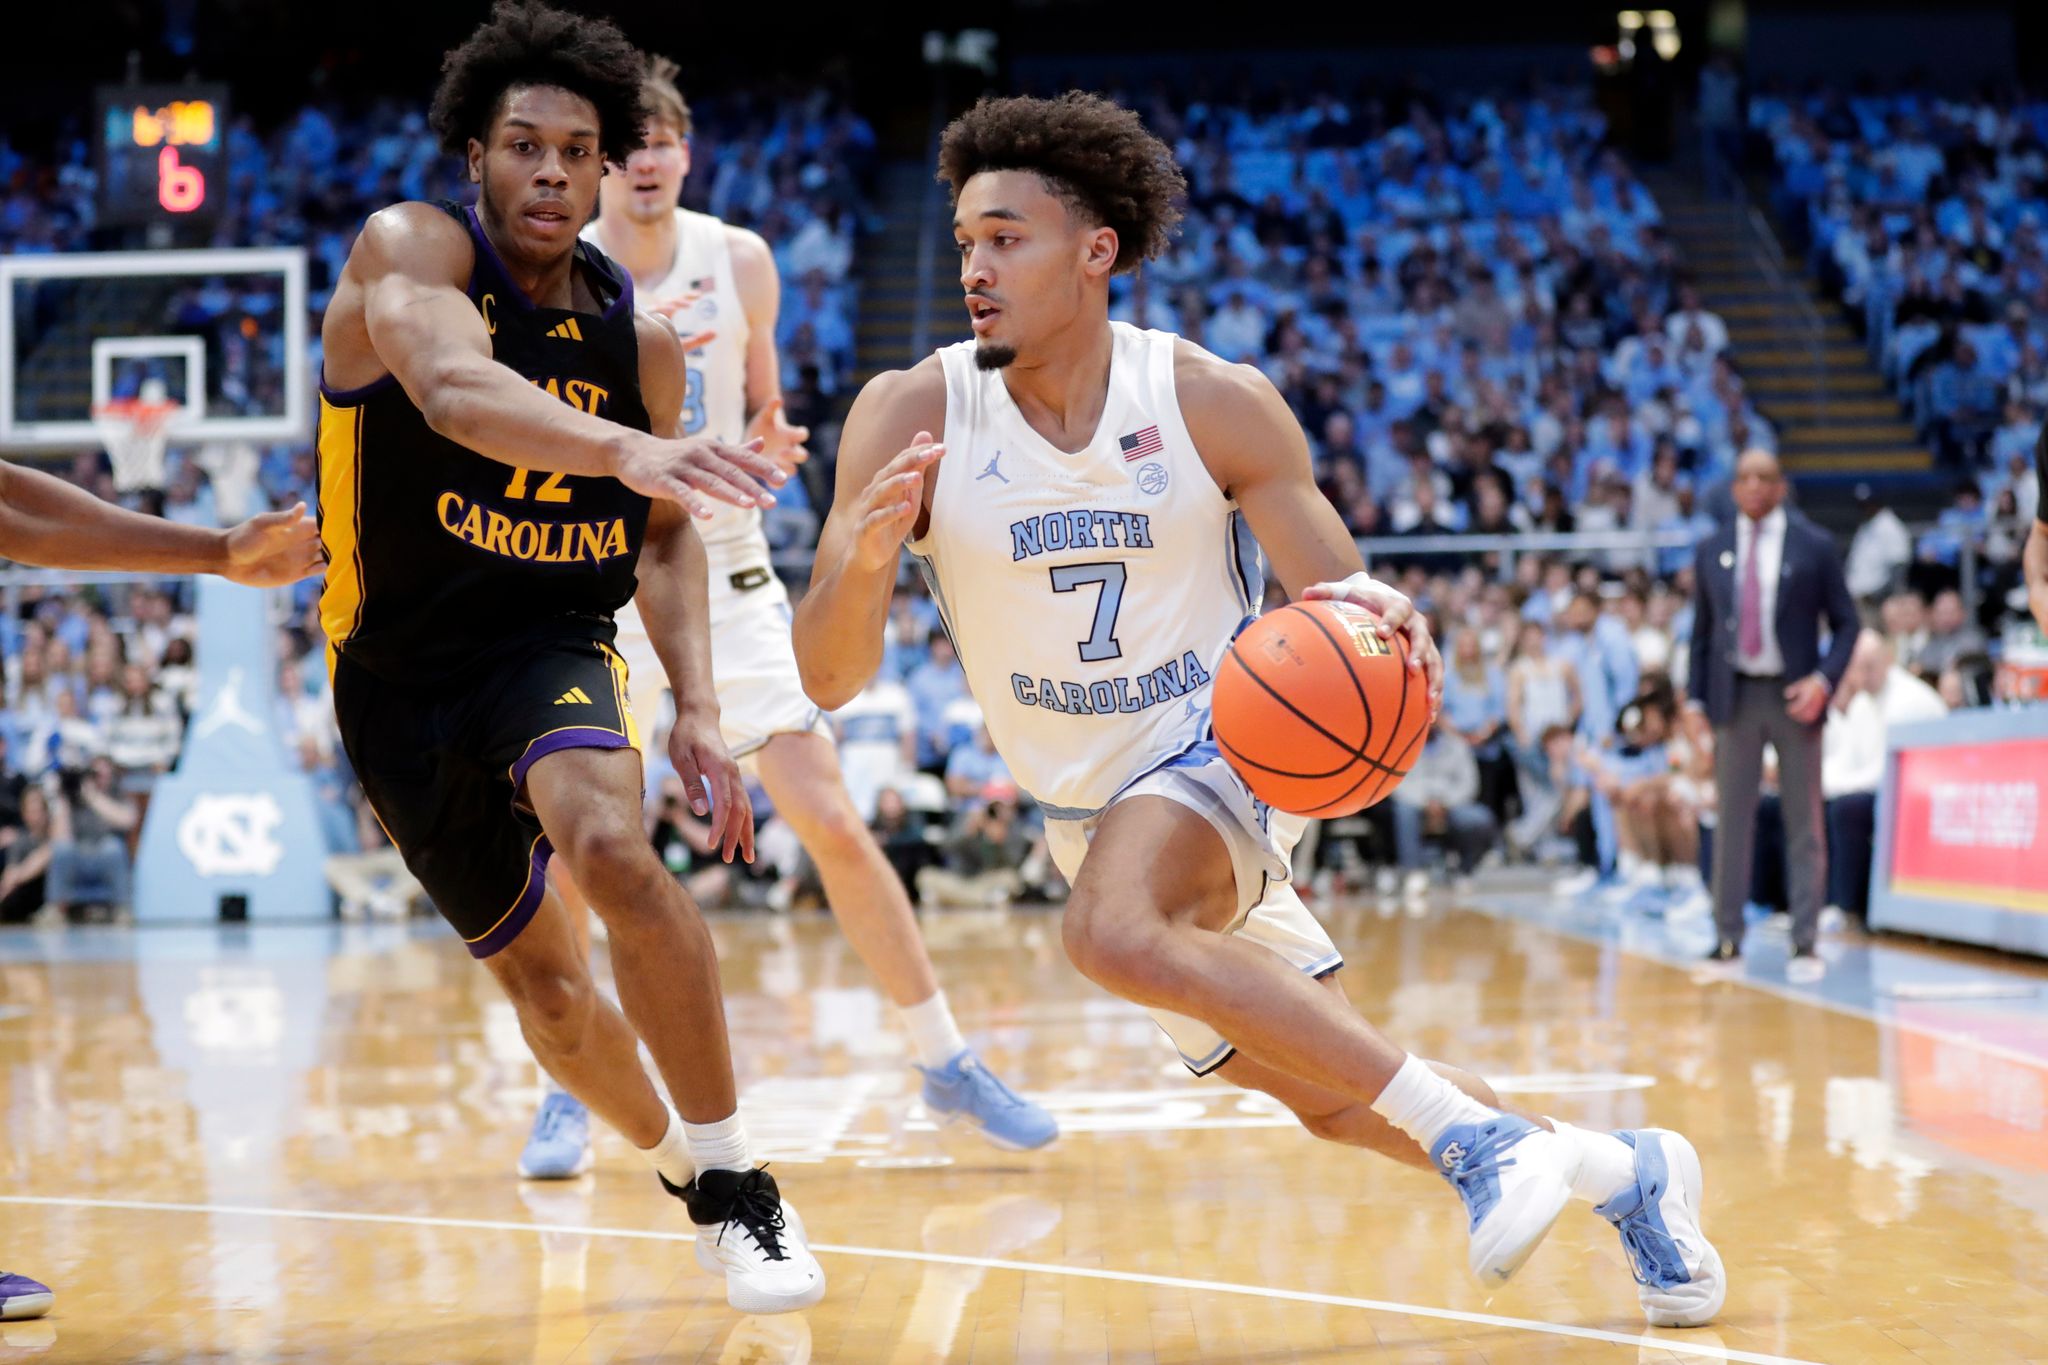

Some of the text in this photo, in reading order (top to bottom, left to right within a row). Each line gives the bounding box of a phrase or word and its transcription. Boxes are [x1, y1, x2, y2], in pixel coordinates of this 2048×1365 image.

[528, 376, 610, 418] AST
[436, 490, 630, 565] CAROLINA
[1010, 509, 1154, 562] NORTH
[1049, 561, 1127, 663] 7
[1011, 650, 1211, 715] CAROLINA
